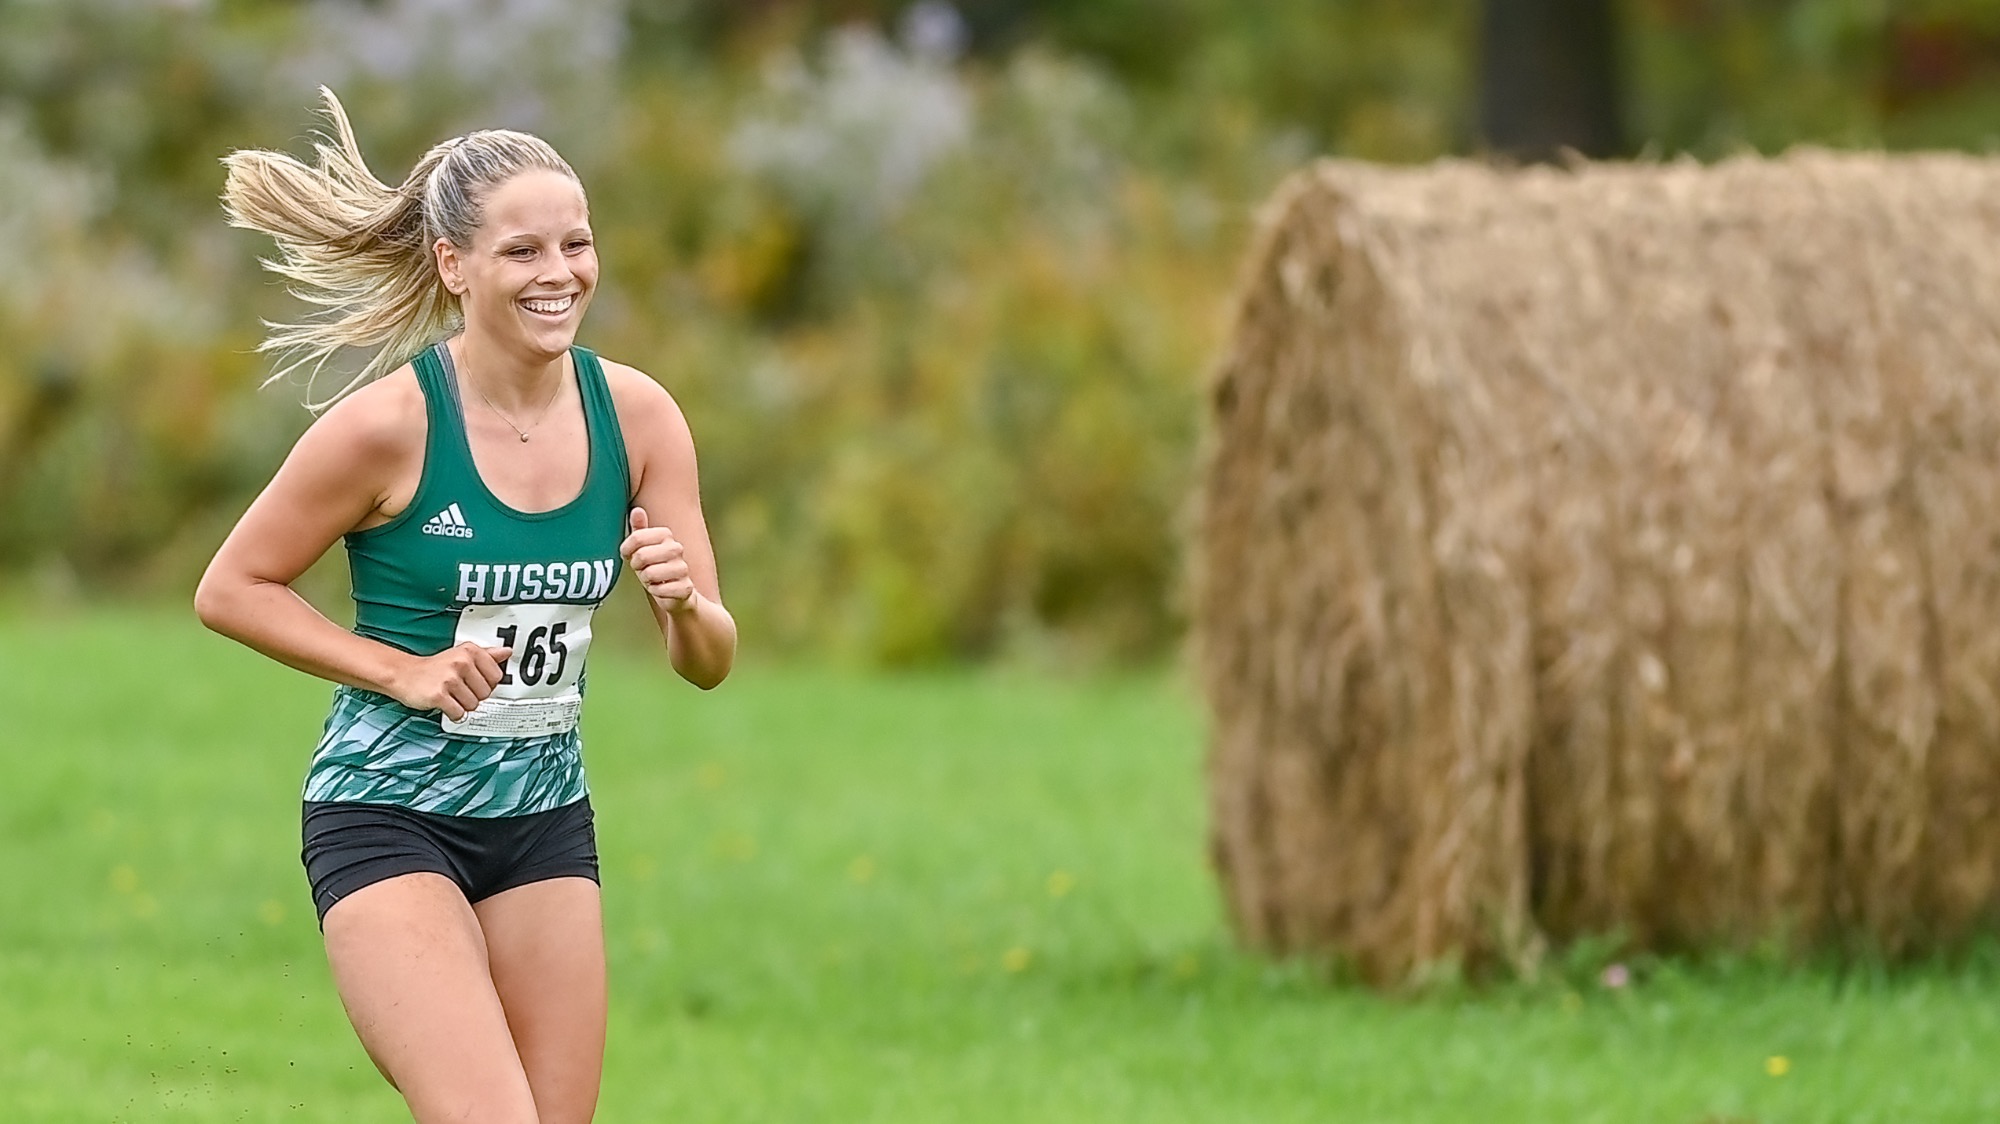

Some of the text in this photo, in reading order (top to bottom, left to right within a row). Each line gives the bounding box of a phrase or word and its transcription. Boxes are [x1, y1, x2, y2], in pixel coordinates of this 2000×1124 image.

[422, 522, 473, 538] adidas
[455, 558, 615, 603] HUSSON
[496, 622, 569, 687] 165
